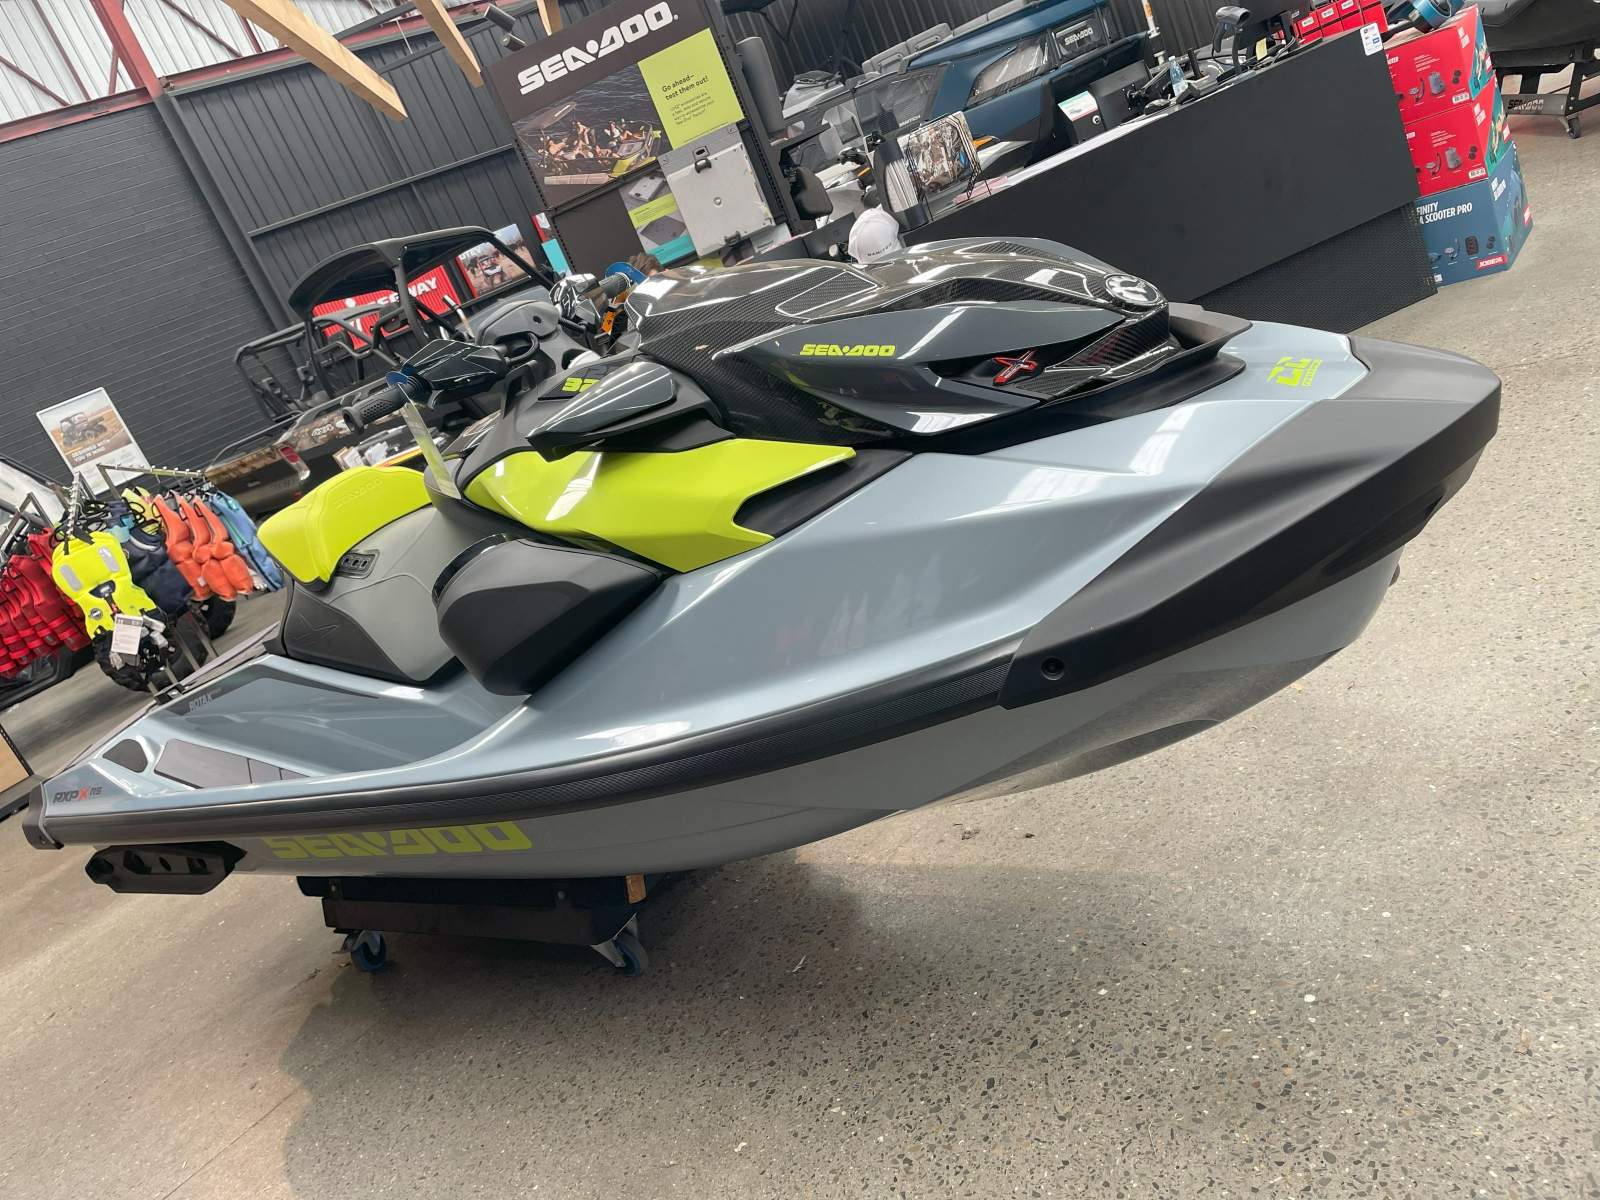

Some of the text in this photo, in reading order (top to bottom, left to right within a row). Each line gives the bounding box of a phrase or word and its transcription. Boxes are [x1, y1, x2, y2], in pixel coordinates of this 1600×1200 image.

[662, 85, 671, 93] Go
[665, 90, 679, 101] test
[679, 83, 695, 94] them
[1425, 207, 1456, 224] SCOOTER
[1457, 202, 1473, 216] PRO
